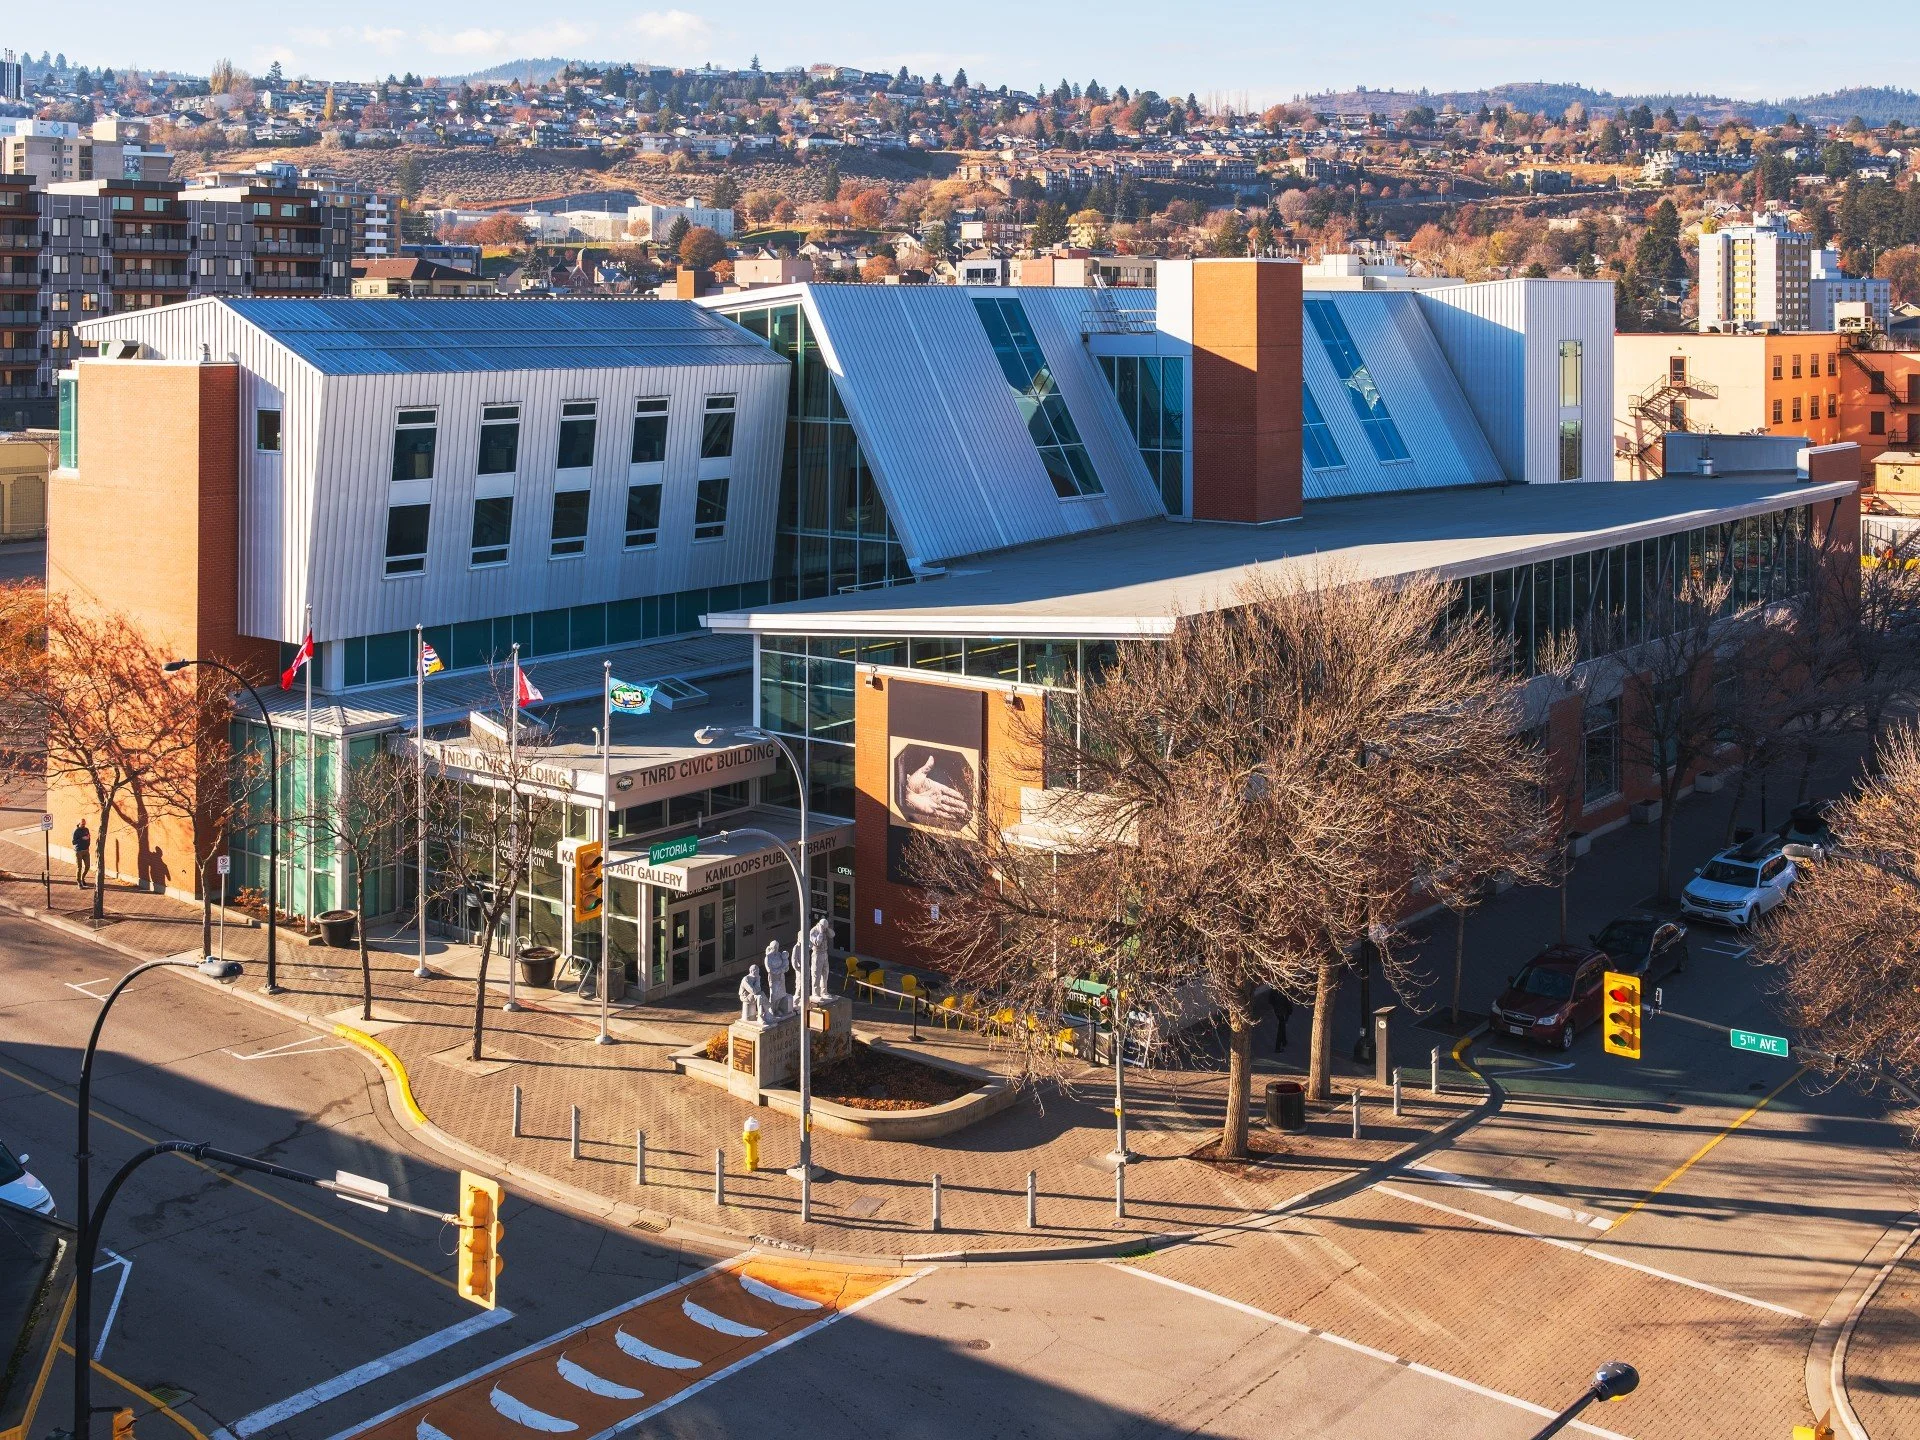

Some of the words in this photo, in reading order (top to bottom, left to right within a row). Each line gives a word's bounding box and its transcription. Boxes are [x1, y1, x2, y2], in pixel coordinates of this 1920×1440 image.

[640, 765, 676, 787] TNRD
[680, 756, 713, 778] CIVIC
[717, 743, 774, 770] BUILDING
[652, 843, 688, 861] VICTORIA
[688, 844, 696, 852] ST
[705, 857, 761, 883] KAMLOOPS
[763, 847, 797, 868] PUBLC
[799, 836, 837, 860] BRARY
[616, 863, 635, 877] ART
[638, 867, 683, 887] GALLERY
[838, 866, 852, 876] OPEN
[1740, 1034, 1756, 1046] 5TH
[1759, 1039, 1780, 1052] AVE.
